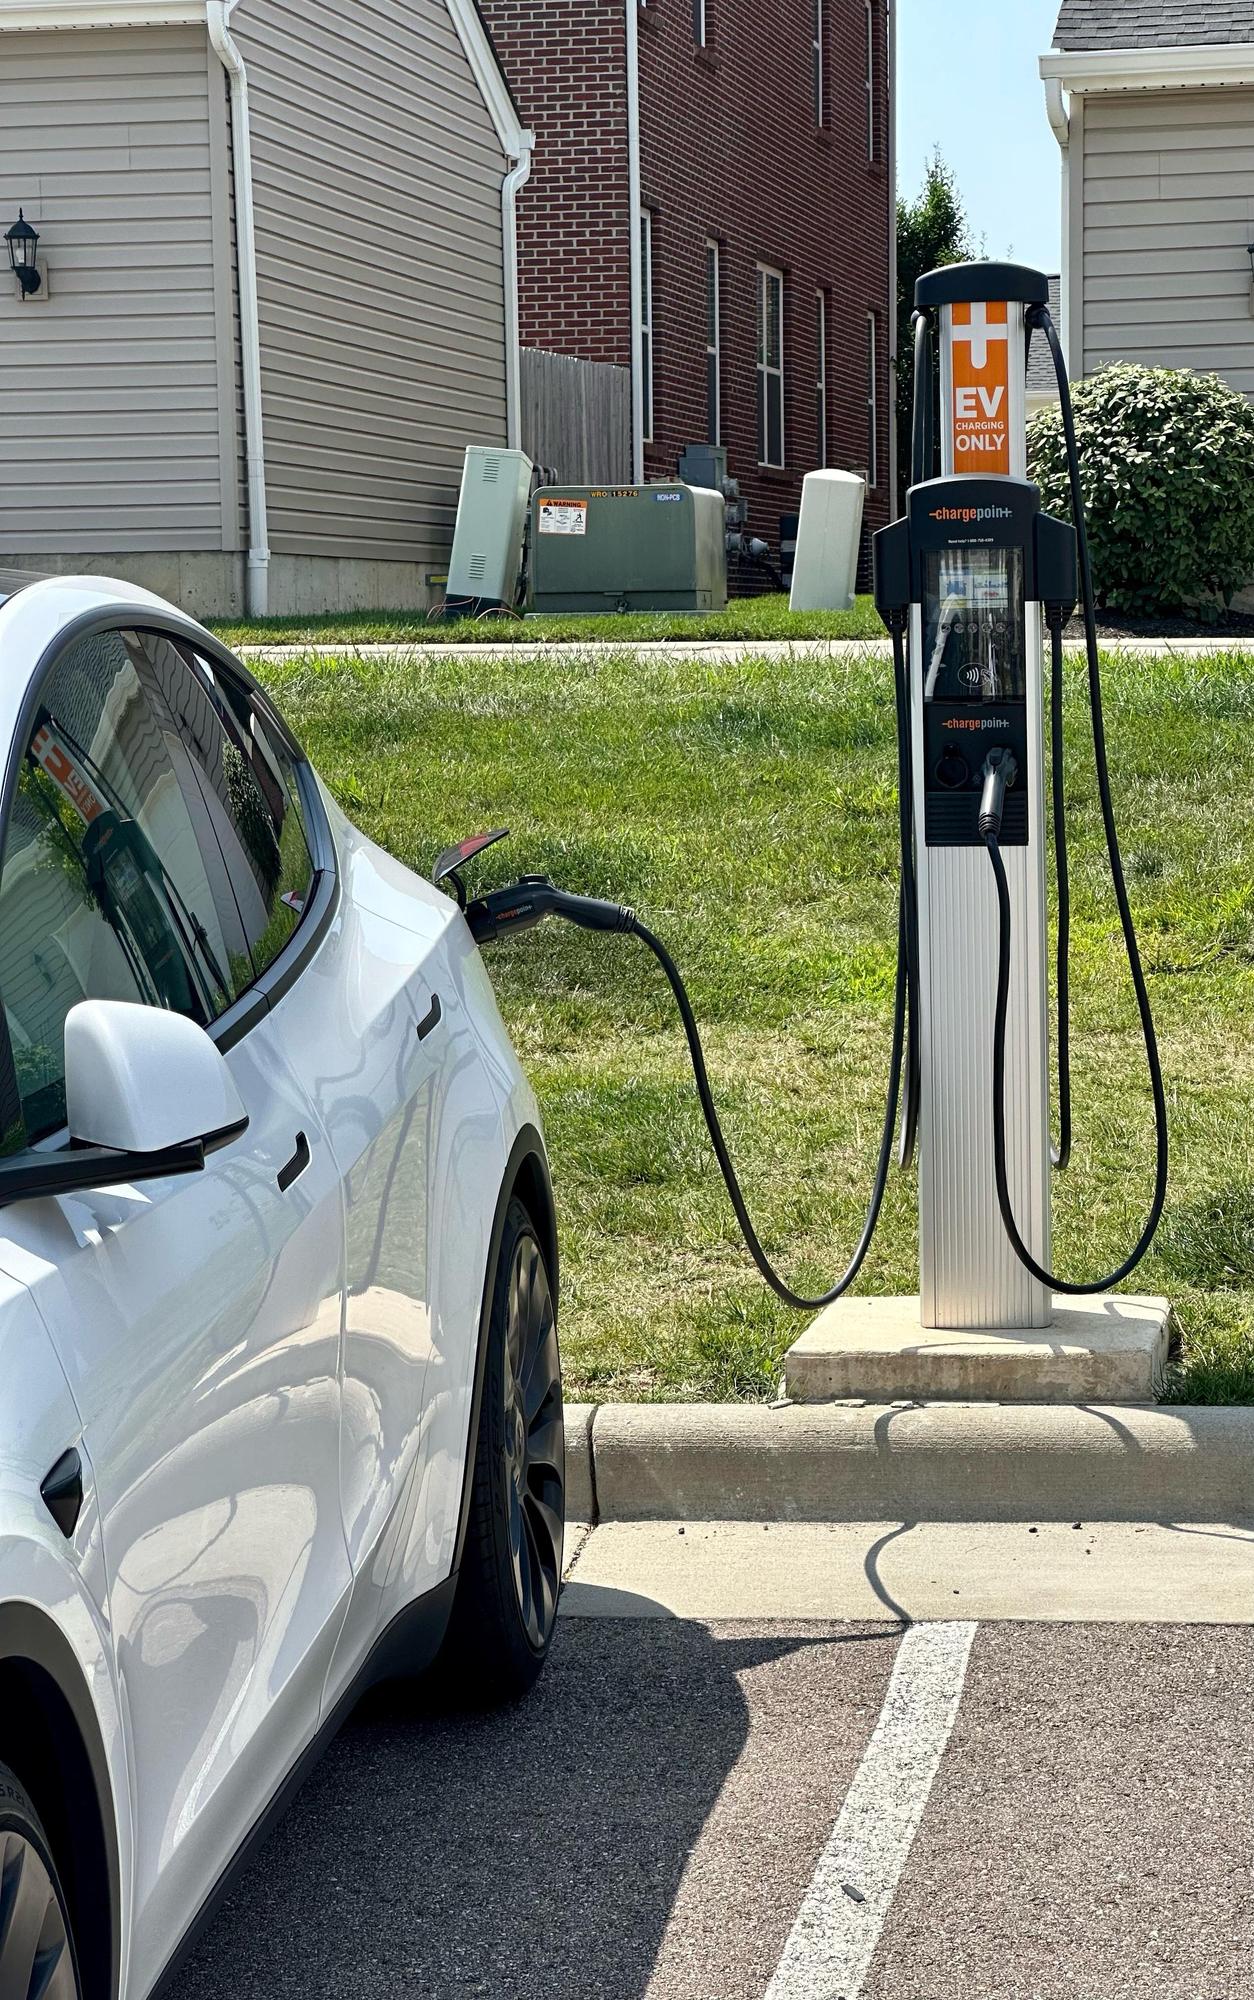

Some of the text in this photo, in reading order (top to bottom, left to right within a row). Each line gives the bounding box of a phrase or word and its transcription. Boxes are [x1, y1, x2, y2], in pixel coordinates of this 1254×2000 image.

[956, 387, 1004, 418] EV
[956, 422, 1004, 430] CHARGING
[956, 434, 1005, 451] ONLY
